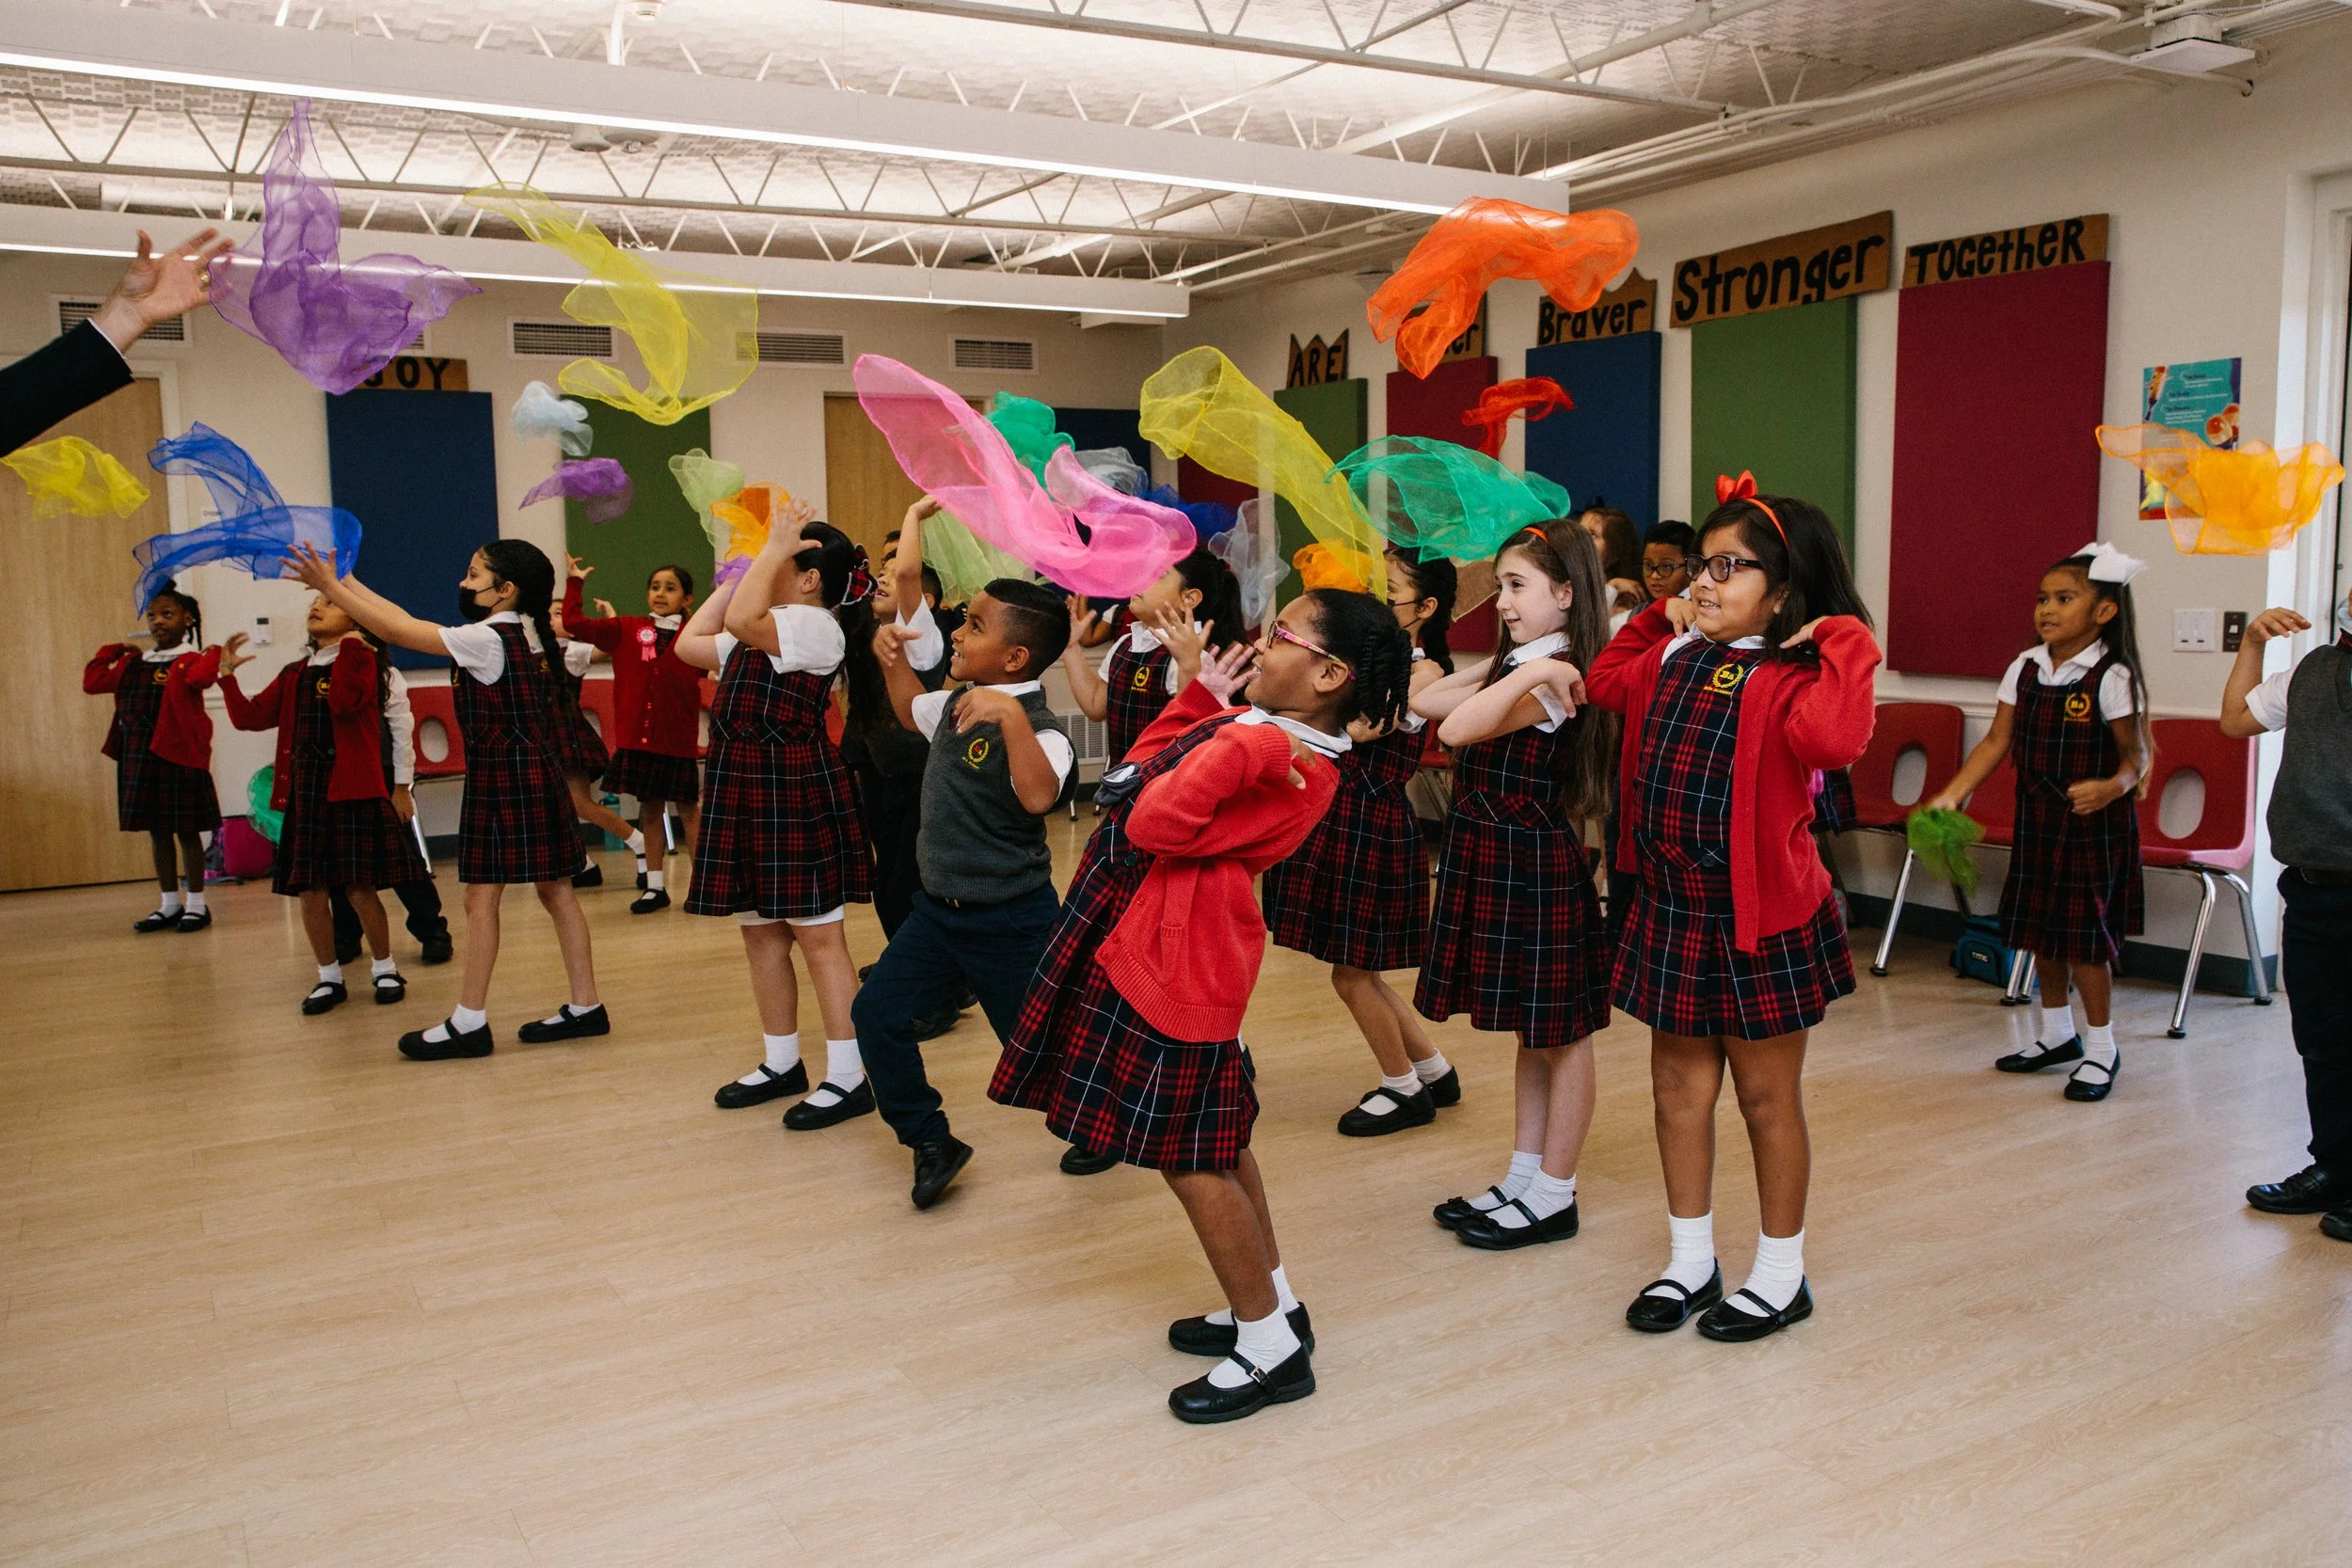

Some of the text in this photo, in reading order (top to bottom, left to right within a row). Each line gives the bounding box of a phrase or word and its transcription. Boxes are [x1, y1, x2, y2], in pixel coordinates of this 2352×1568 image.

[1674, 235, 1885, 322] Stronger
[1538, 298, 1648, 345] Braver
[363, 356, 451, 391] JOY
[1289, 345, 1343, 388] ARE
